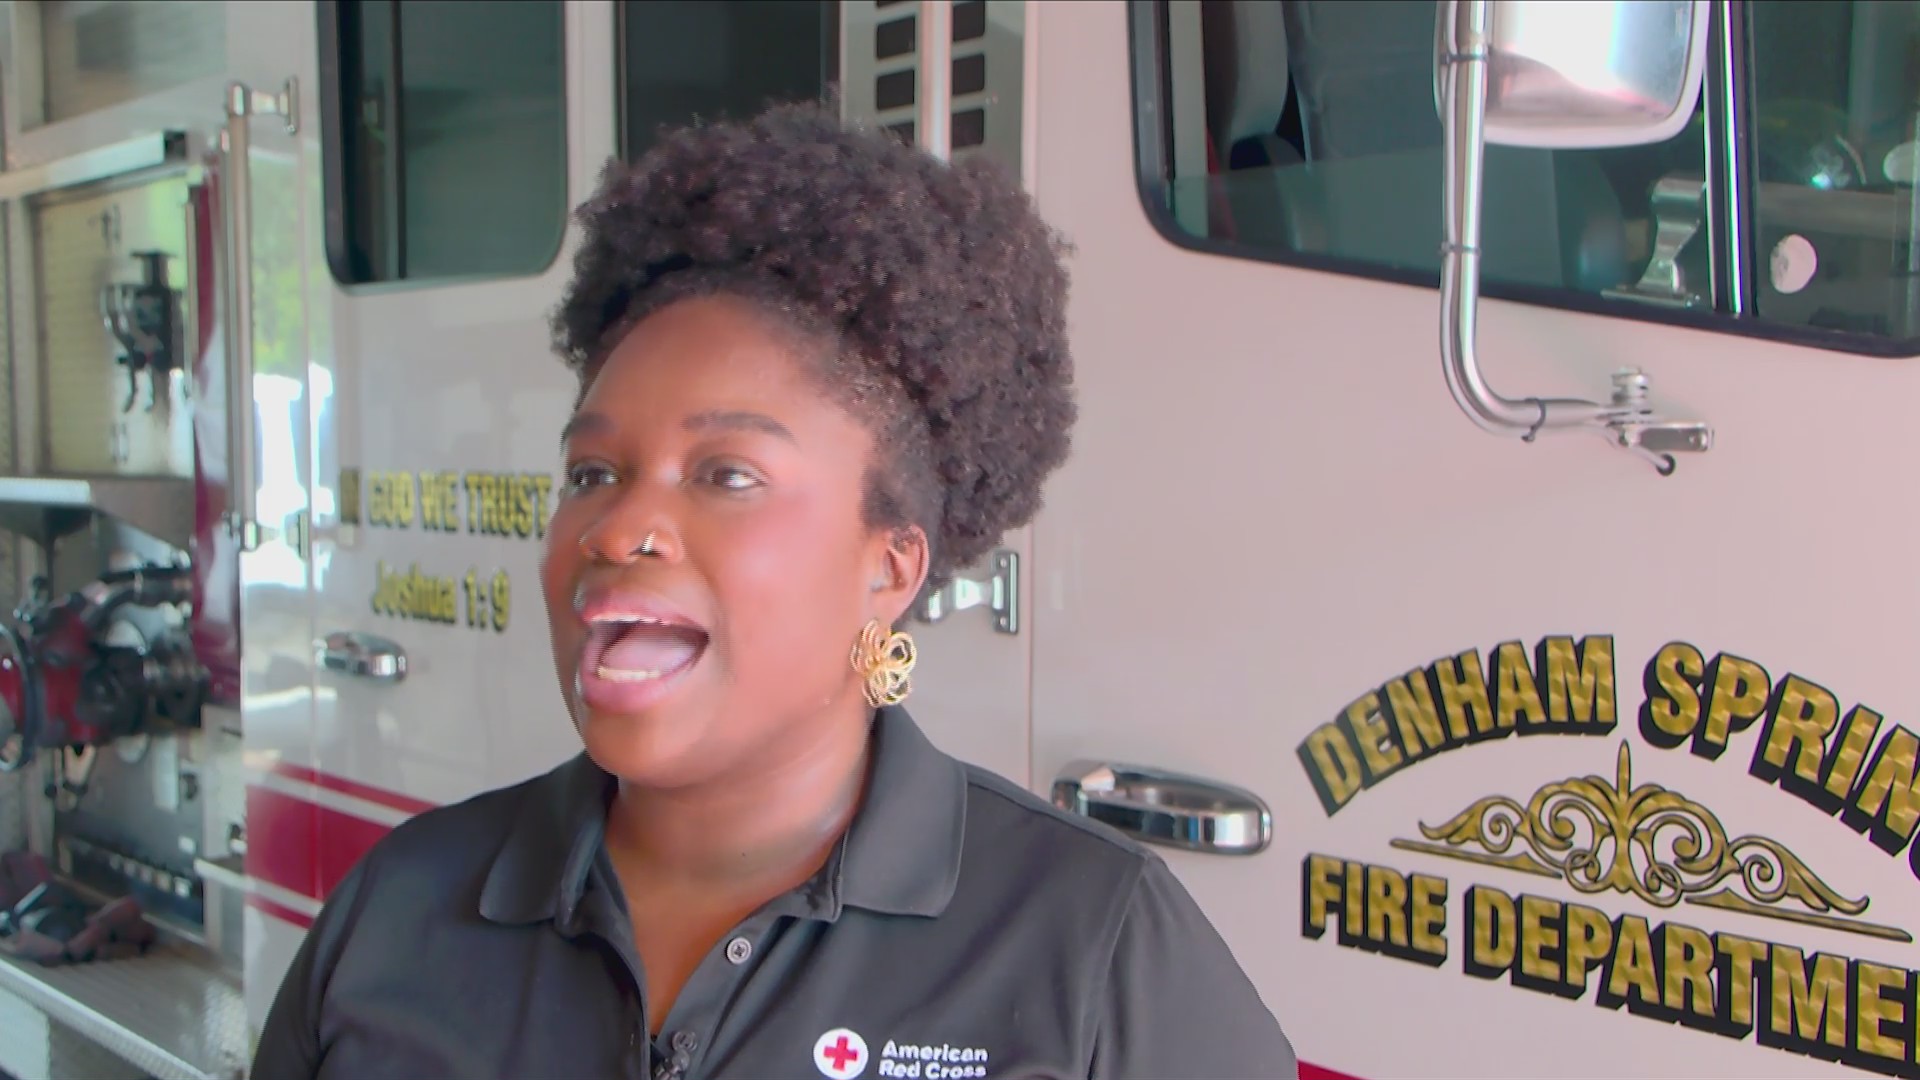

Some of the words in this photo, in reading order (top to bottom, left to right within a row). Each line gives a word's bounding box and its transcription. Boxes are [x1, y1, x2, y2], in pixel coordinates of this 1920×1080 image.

[369, 470, 414, 529] GOD
[420, 471, 459, 533] WE
[464, 473, 553, 541] TRUST
[372, 560, 457, 625] Joshua
[1295, 634, 1617, 817] DENHAM
[1638, 641, 1920, 883] SPRIN
[1301, 853, 1448, 968] FIRE
[1463, 884, 1920, 1080] DEPARTME
[878, 1059, 921, 1078] Red
[924, 1061, 987, 1079] Cross
[881, 1039, 989, 1062] American
